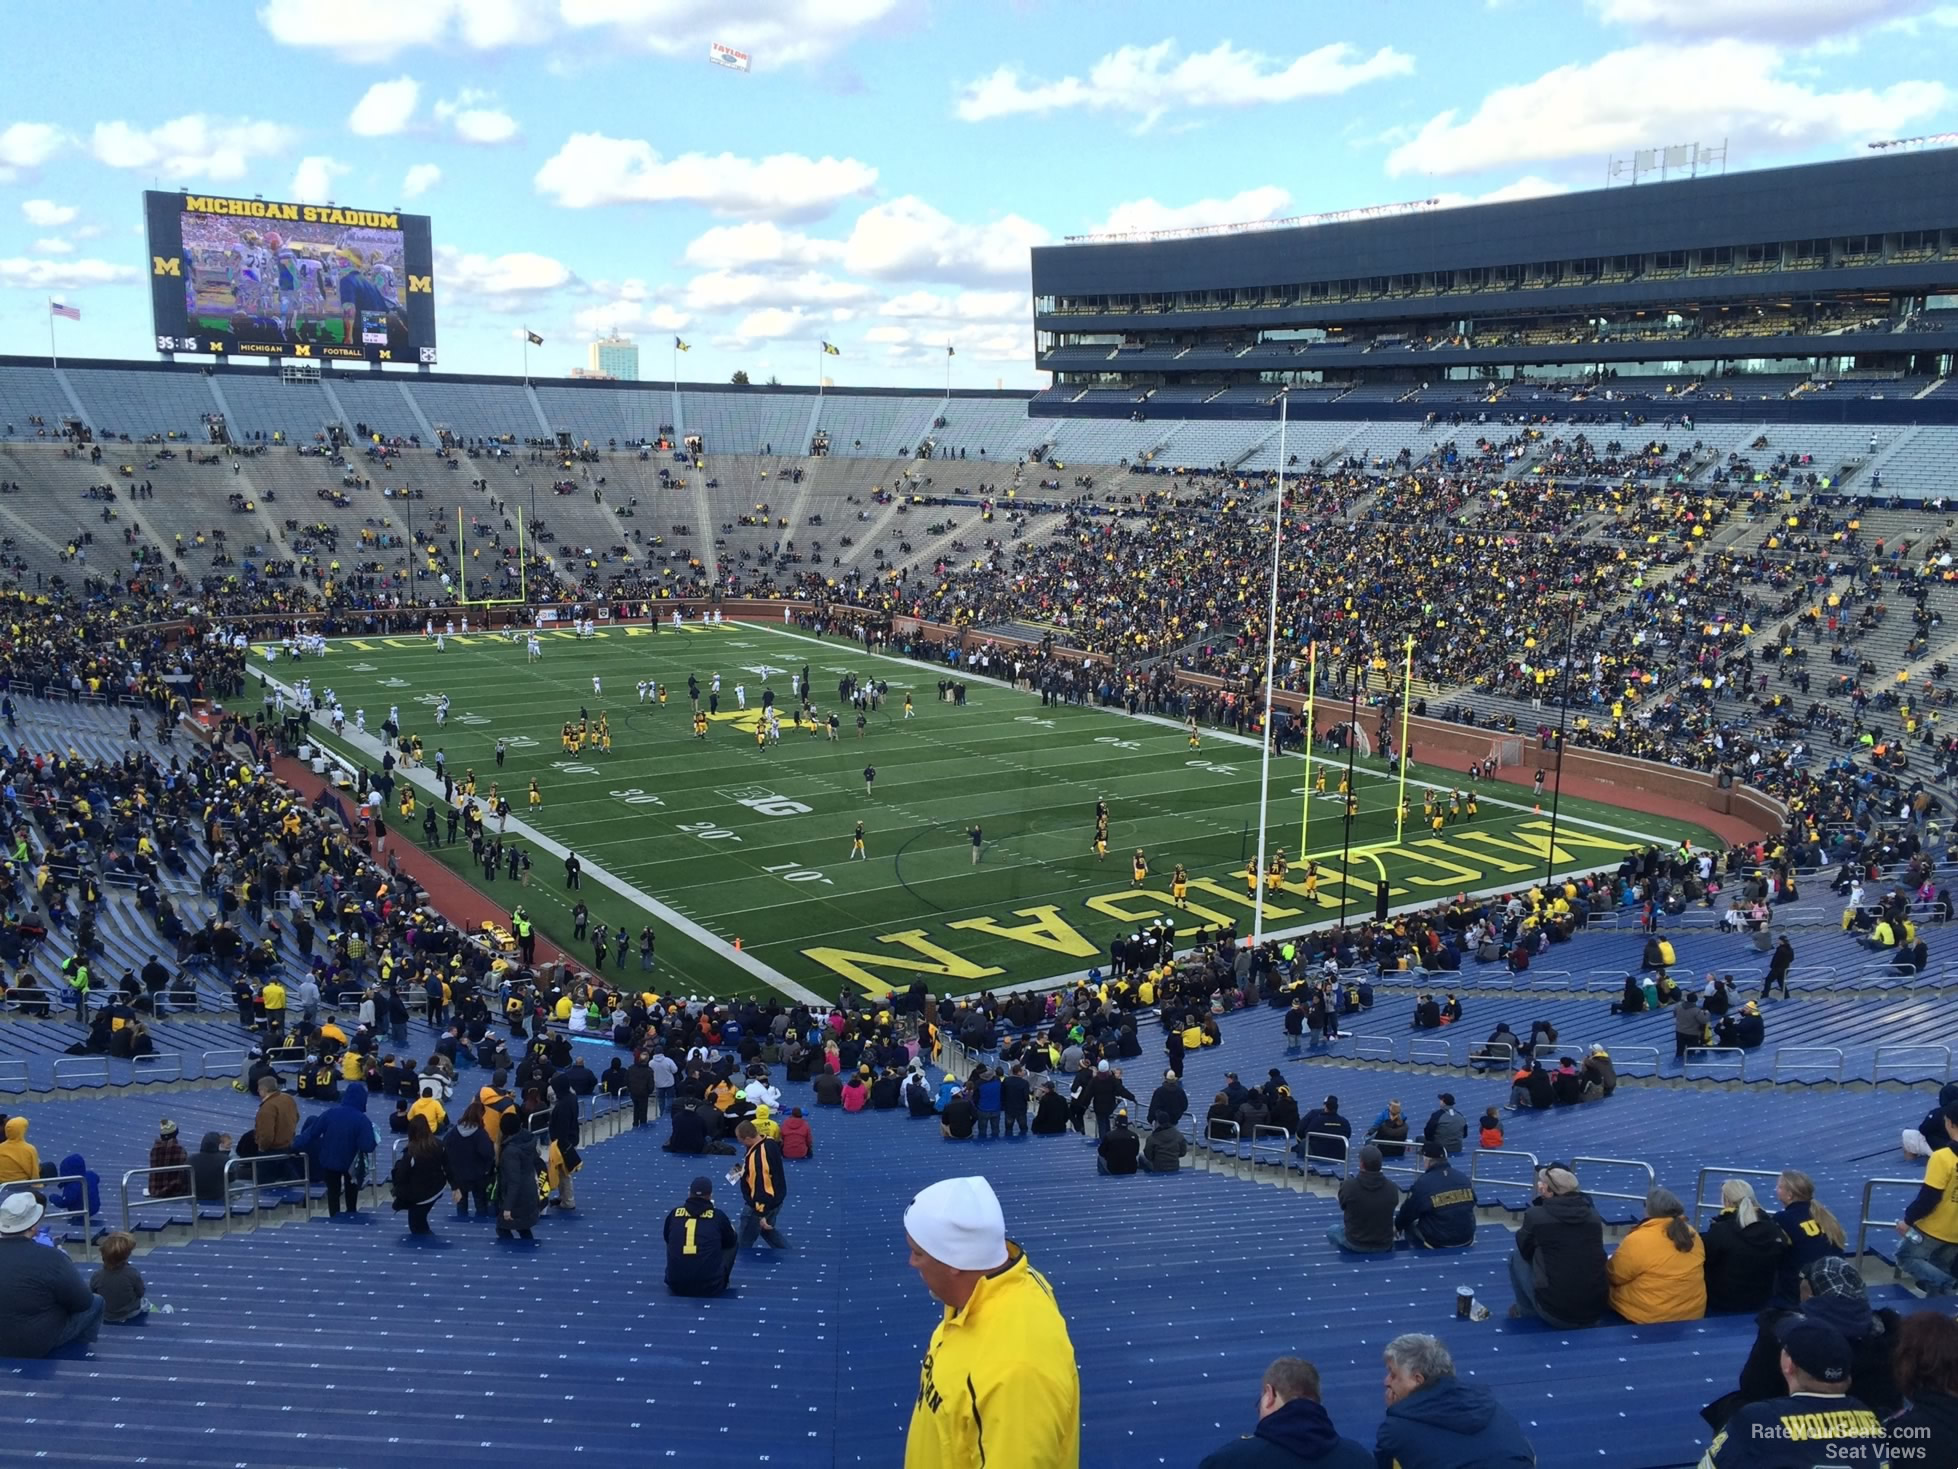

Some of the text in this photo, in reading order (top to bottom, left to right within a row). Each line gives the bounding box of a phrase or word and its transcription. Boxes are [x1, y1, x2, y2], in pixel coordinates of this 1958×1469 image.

[712, 42, 748, 60] TAYLOR
[185, 196, 399, 229] MICHIGAN STADIUM
[153, 256, 181, 277] M
[408, 275, 432, 294] M
[209, 341, 224, 352] M
[240, 344, 363, 357] MICHIGAN M FOOTBALL
[379, 350, 392, 360] M
[550, 761, 595, 774] 40
[609, 788, 660, 804] 30
[675, 821, 735, 840] 20
[761, 861, 824, 882] 10
[800, 820, 1645, 999] MICHIGAN
[607, 996, 617, 1008] 21
[533, 1042, 546, 1055] 47
[316, 1070, 332, 1086] 20
[682, 1218, 697, 1255] 1
